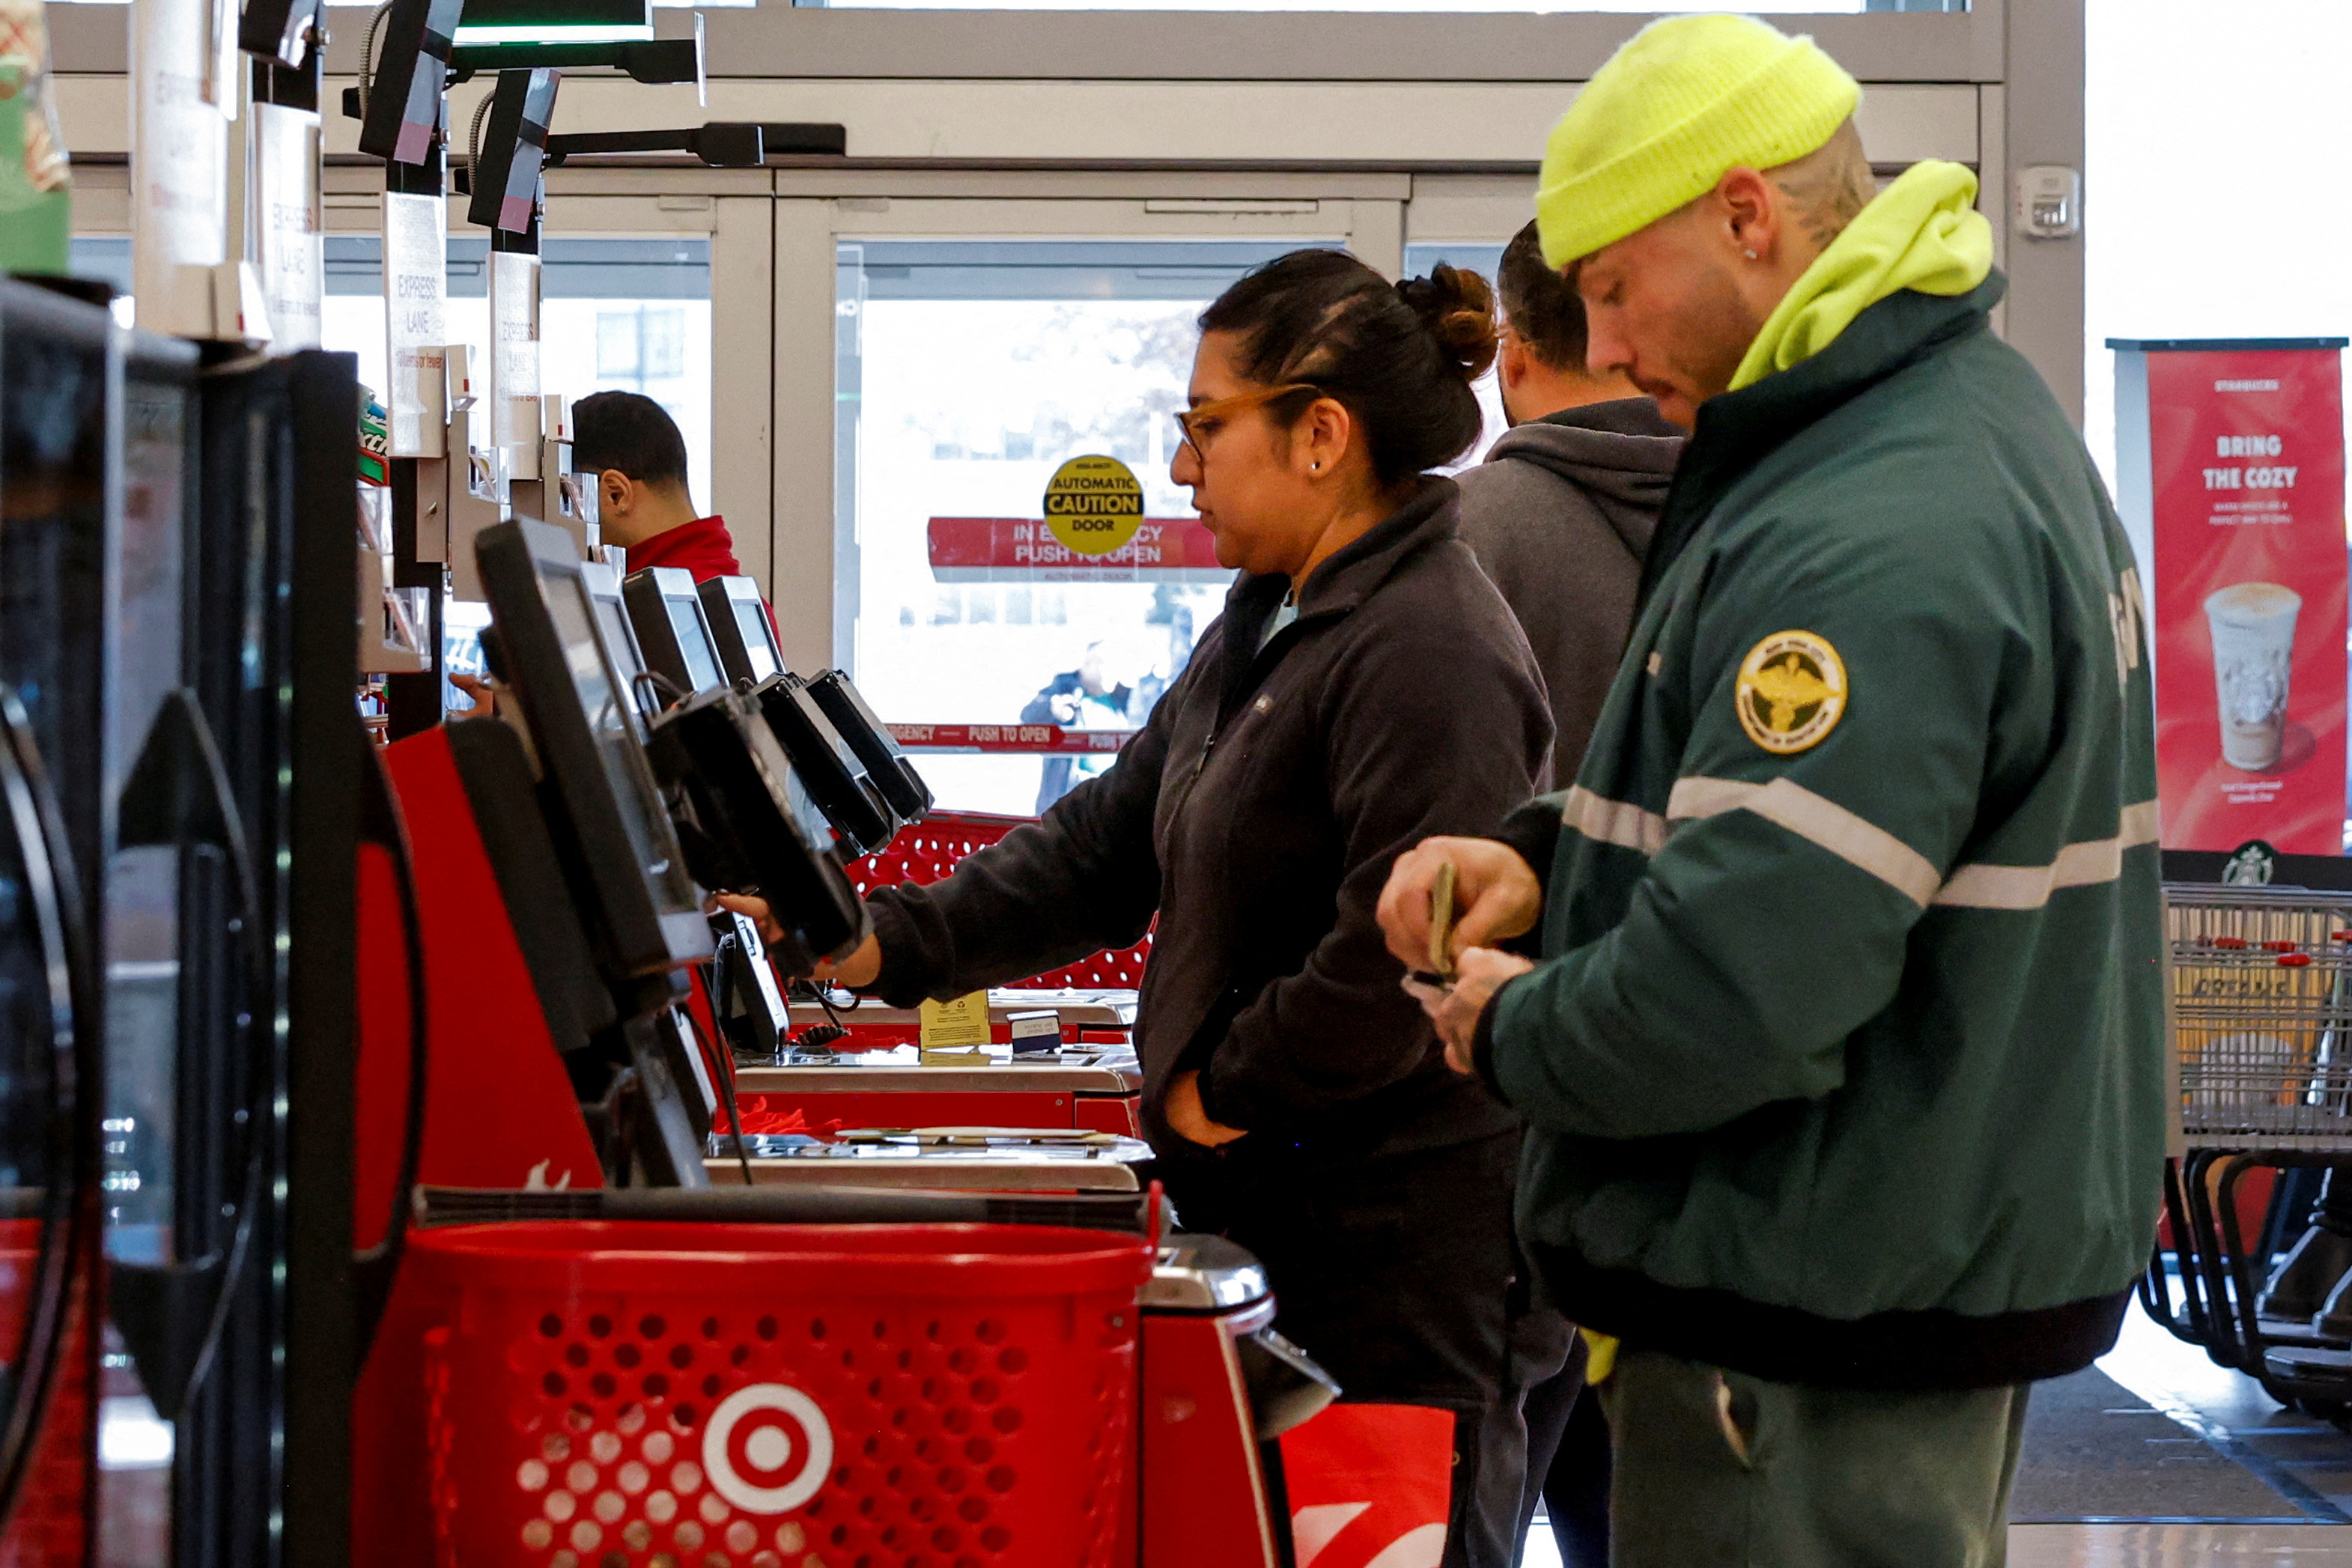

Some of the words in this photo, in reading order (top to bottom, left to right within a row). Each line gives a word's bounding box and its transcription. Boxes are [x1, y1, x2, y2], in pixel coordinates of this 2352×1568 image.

[398, 274, 437, 300] EXPRESS
[407, 310, 429, 333] LANE
[2216, 435, 2282, 458] BRING
[1054, 476, 1134, 490] AUTOMATIC
[2202, 467, 2242, 490] THE
[2245, 466, 2298, 489] COZY
[1048, 494, 1138, 514] CAUTION
[1013, 524, 1033, 541] IN
[1072, 520, 1114, 531] DOOR
[1015, 544, 1070, 562] PUSH
[969, 725, 1000, 741] PUSH
[1002, 726, 1017, 741] TO
[1019, 726, 1051, 742] OPEN
